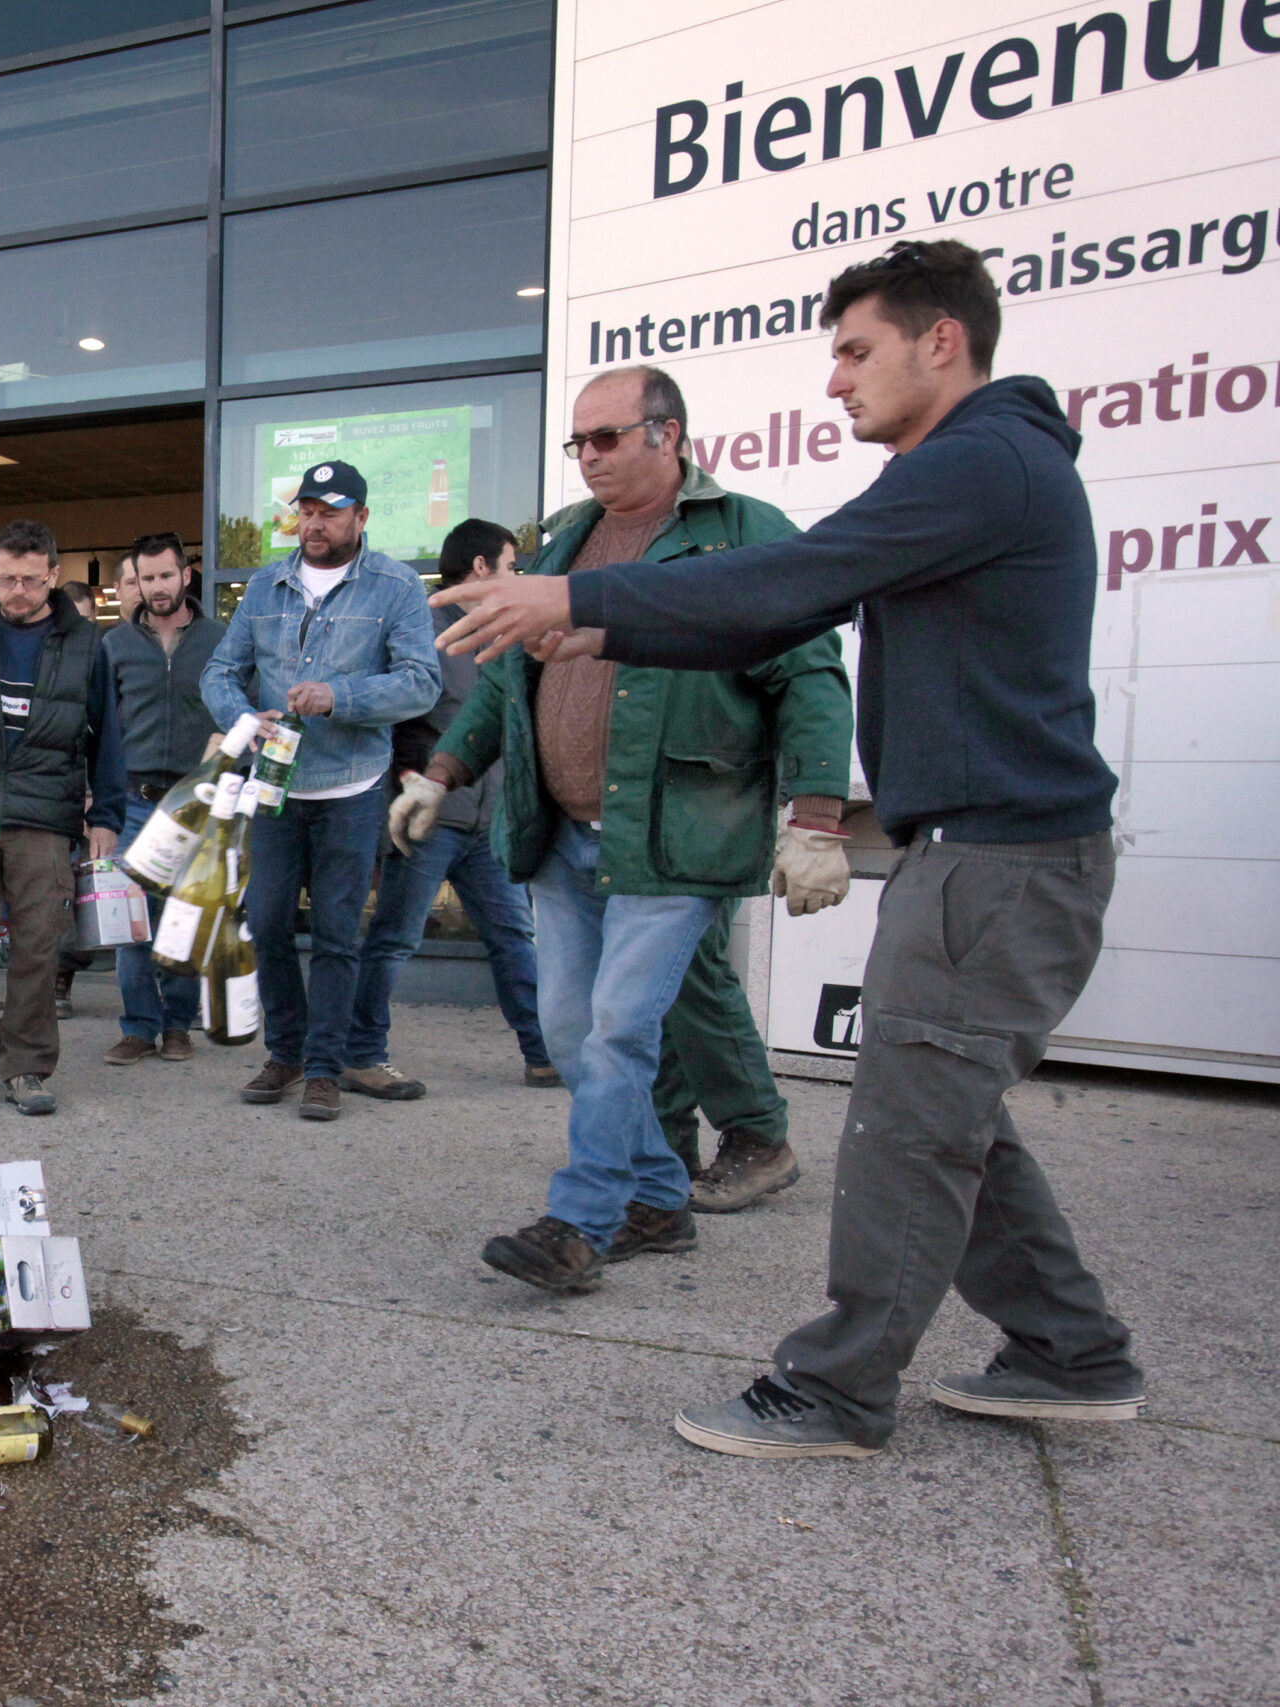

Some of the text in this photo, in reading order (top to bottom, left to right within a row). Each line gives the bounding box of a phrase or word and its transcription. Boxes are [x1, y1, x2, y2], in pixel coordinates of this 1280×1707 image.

[791, 162, 1075, 251] dans votre
[589, 205, 1280, 365] Intermar aissarg
[412, 419, 448, 430] FRUITS
[692, 351, 1280, 475] velle ratio
[1106, 502, 1273, 591] prix
